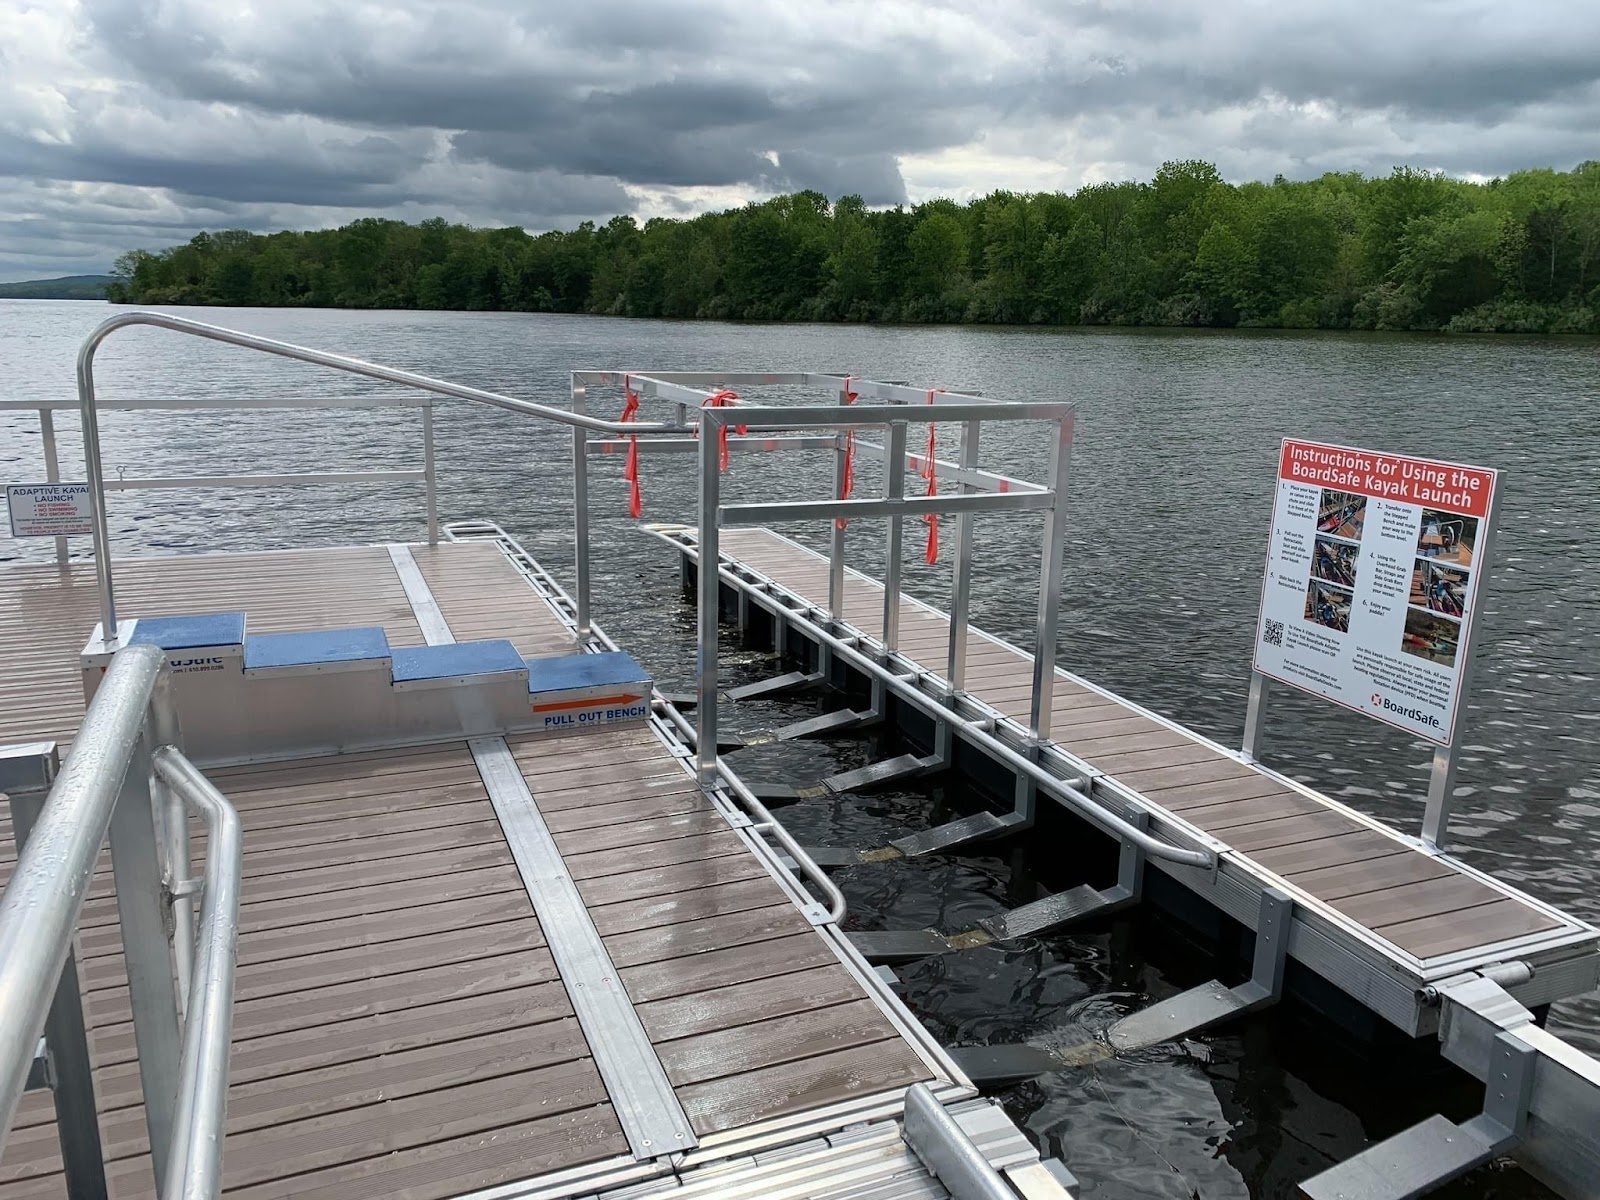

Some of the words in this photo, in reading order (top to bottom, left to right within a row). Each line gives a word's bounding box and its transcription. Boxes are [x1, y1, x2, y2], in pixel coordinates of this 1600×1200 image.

[1291, 446, 1371, 472] Instructions
[1376, 458, 1398, 476] for
[1402, 463, 1446, 488] Using
[1452, 472, 1480, 490] the
[13, 487, 59, 496] ADAPTIVE
[1292, 462, 1360, 487] BoardSafe
[1365, 475, 1408, 497] Kayak
[1413, 485, 1472, 507] Launch
[1376, 561, 1395, 569] Overhead
[1364, 656, 1383, 666] personally
[1384, 663, 1407, 673] responsible
[1354, 666, 1368, 675] boating
[1429, 693, 1448, 702] personal
[1380, 668, 1395, 676] observe
[1434, 687, 1449, 695] federal
[545, 715, 574, 725] PULL
[579, 711, 603, 721] OUT
[607, 706, 645, 719] BENCH
[1383, 699, 1439, 728] BoardSafe
